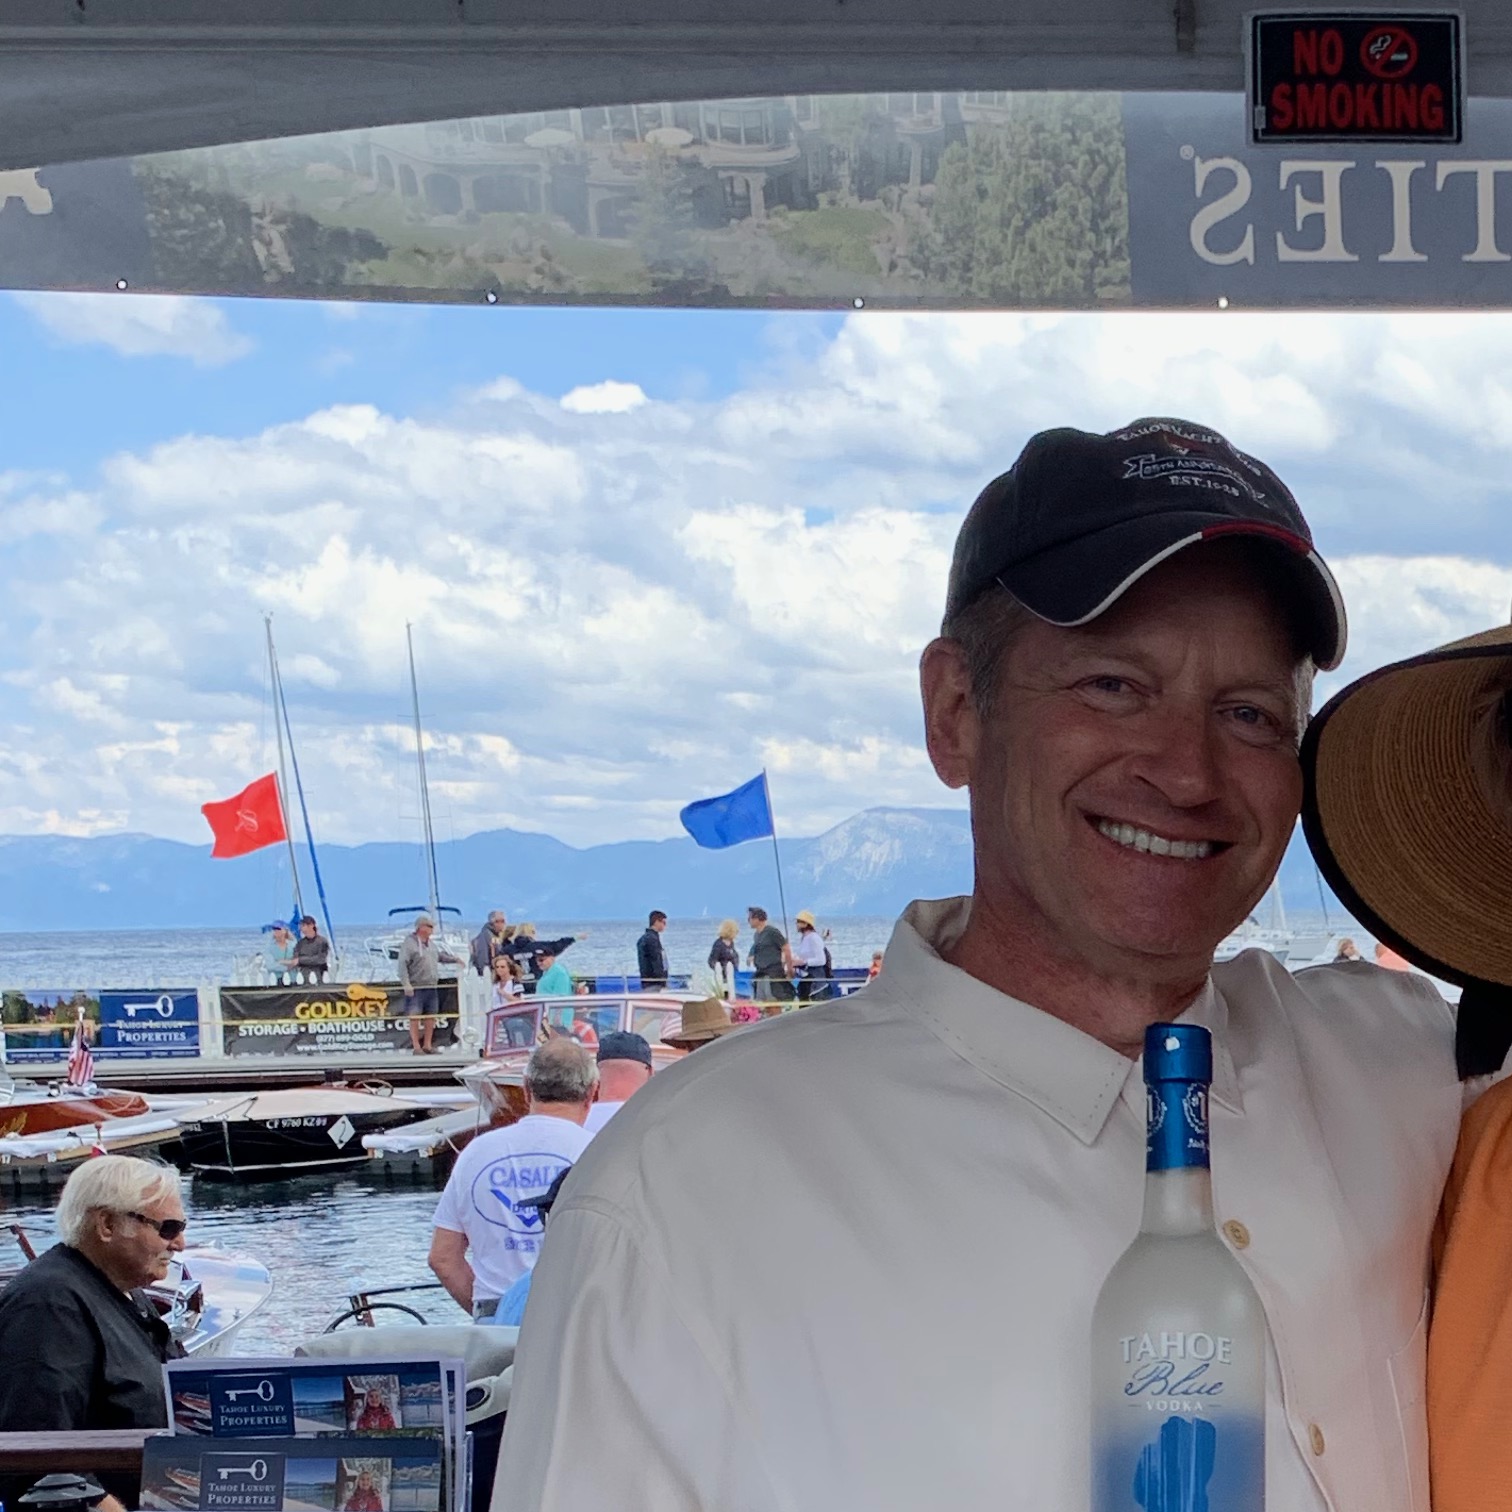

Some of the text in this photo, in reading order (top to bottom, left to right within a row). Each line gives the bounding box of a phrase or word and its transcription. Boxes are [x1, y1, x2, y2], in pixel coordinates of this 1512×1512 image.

[1293, 28, 1344, 77] NO
[1272, 82, 1444, 131] SMOKING
[295, 1000, 389, 1020] GOLDKEY
[239, 1017, 449, 1037] STORAGE BOATHOUSE CELRS
[117, 1030, 187, 1043] PROPERTIES
[266, 1119, 279, 1130] CF
[1120, 1332, 1232, 1365] TAHOE
[1124, 1360, 1224, 1396] Blue
[219, 1404, 285, 1414] TAHOE LUXURY
[1146, 1400, 1203, 1412] VODKA
[220, 1415, 288, 1427] PROPERTIES
[207, 1482, 277, 1492] TAHOE LUXURY
[207, 1494, 277, 1505] PROPERTIES
